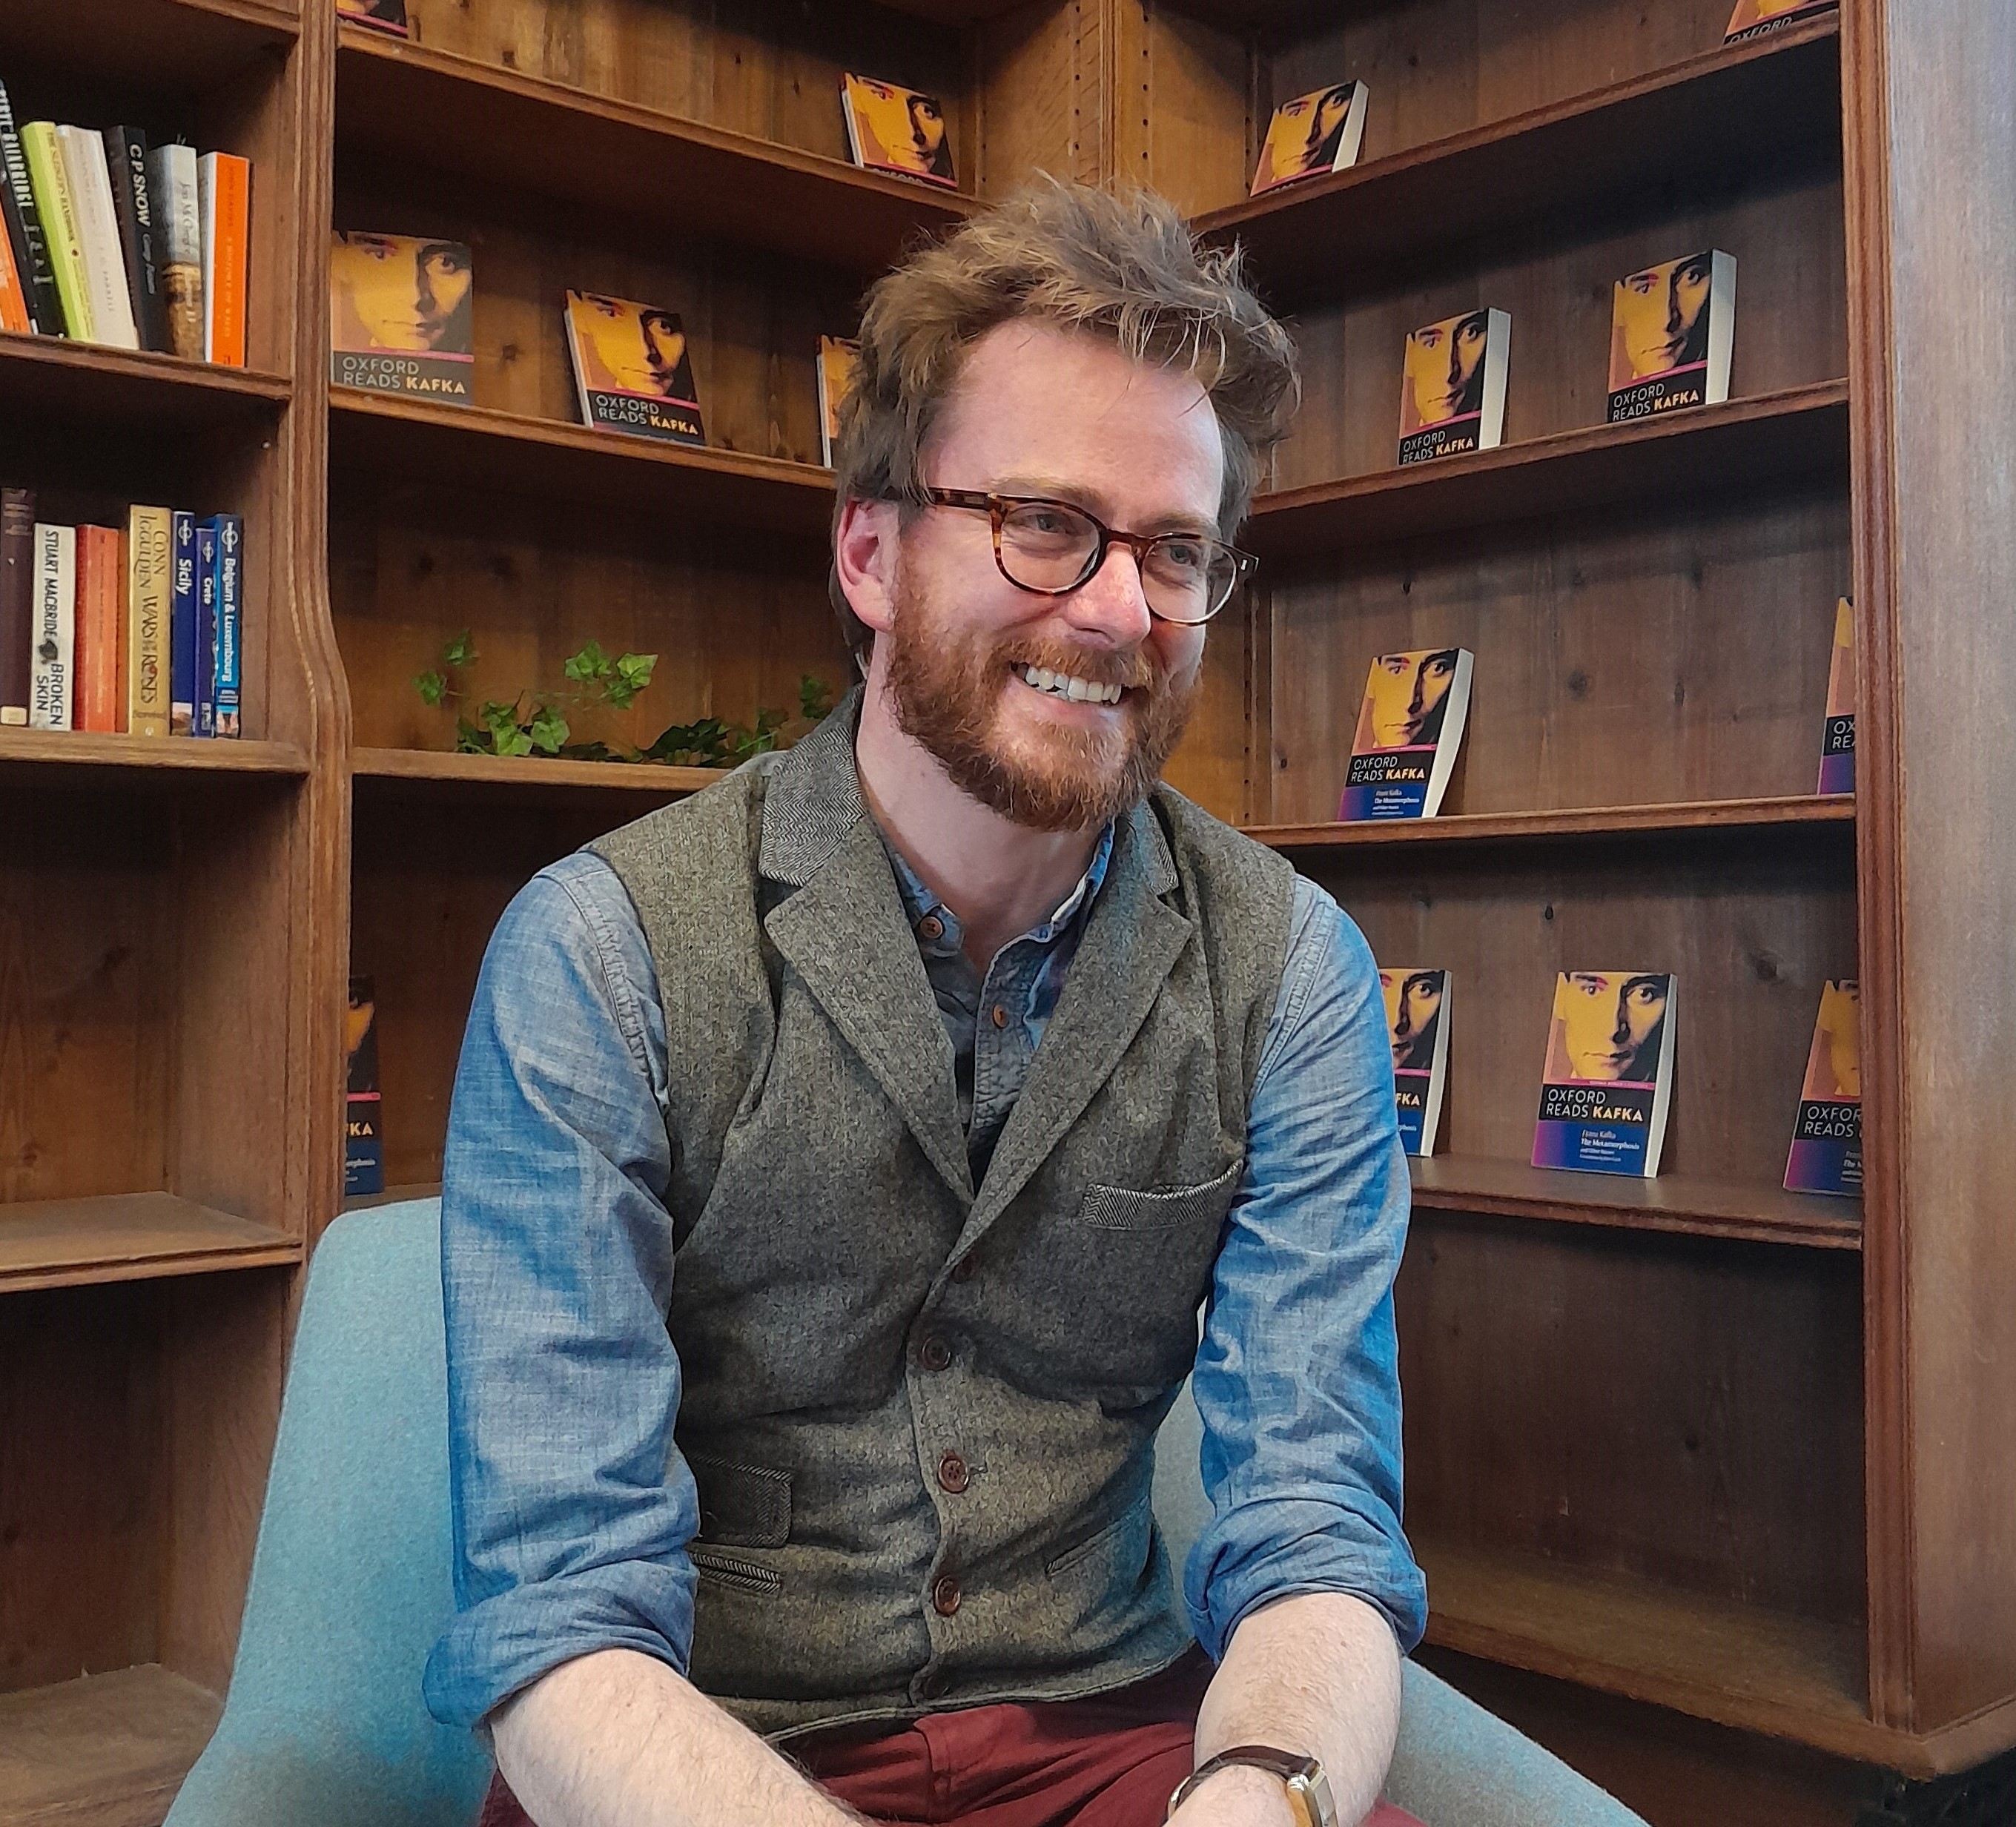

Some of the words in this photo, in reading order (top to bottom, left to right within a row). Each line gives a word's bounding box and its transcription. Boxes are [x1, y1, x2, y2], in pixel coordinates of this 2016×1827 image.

[1731, 16, 1793, 43] OXFORD
[133, 174, 151, 227] SNOW
[343, 356, 420, 375] OXFORD
[343, 371, 401, 389] READS
[406, 377, 466, 394] KAFKA
[1613, 383, 1665, 408] OXFORD
[595, 394, 659, 414] OXFORD
[1613, 400, 1650, 422] READS
[1654, 389, 1699, 411] KAFKA
[598, 407, 647, 425] READS
[650, 415, 698, 435] KAFKA
[1403, 430, 1446, 452] OXFORD
[1403, 446, 1434, 465] READS
[1436, 437, 1473, 455] KAFKA
[44, 530, 59, 575] STUART
[133, 515, 157, 589] IGGULDEN
[153, 530, 168, 575] CONN
[175, 558, 192, 595] Sicily
[223, 558, 237, 602] Belgium
[44, 578, 58, 637] MACBRIDE
[142, 595, 159, 638] WARS
[224, 604, 236, 613] &
[222, 615, 235, 682] Luxembourg
[36, 675, 49, 711] SKIN
[50, 664, 64, 725] BROKEN
[1351, 769, 1384, 782] READS
[1386, 768, 1425, 780] KAFKA
[1354, 756, 1398, 770] OXFORD
[1395, 1092, 1421, 1106] FKA
[1548, 1088, 1606, 1103] OXFORD
[1546, 1103, 1589, 1118] READS
[1593, 1106, 1644, 1122] KAFKA
[1808, 1106, 1862, 1122] OXFOR
[1804, 1121, 1854, 1137] READS
